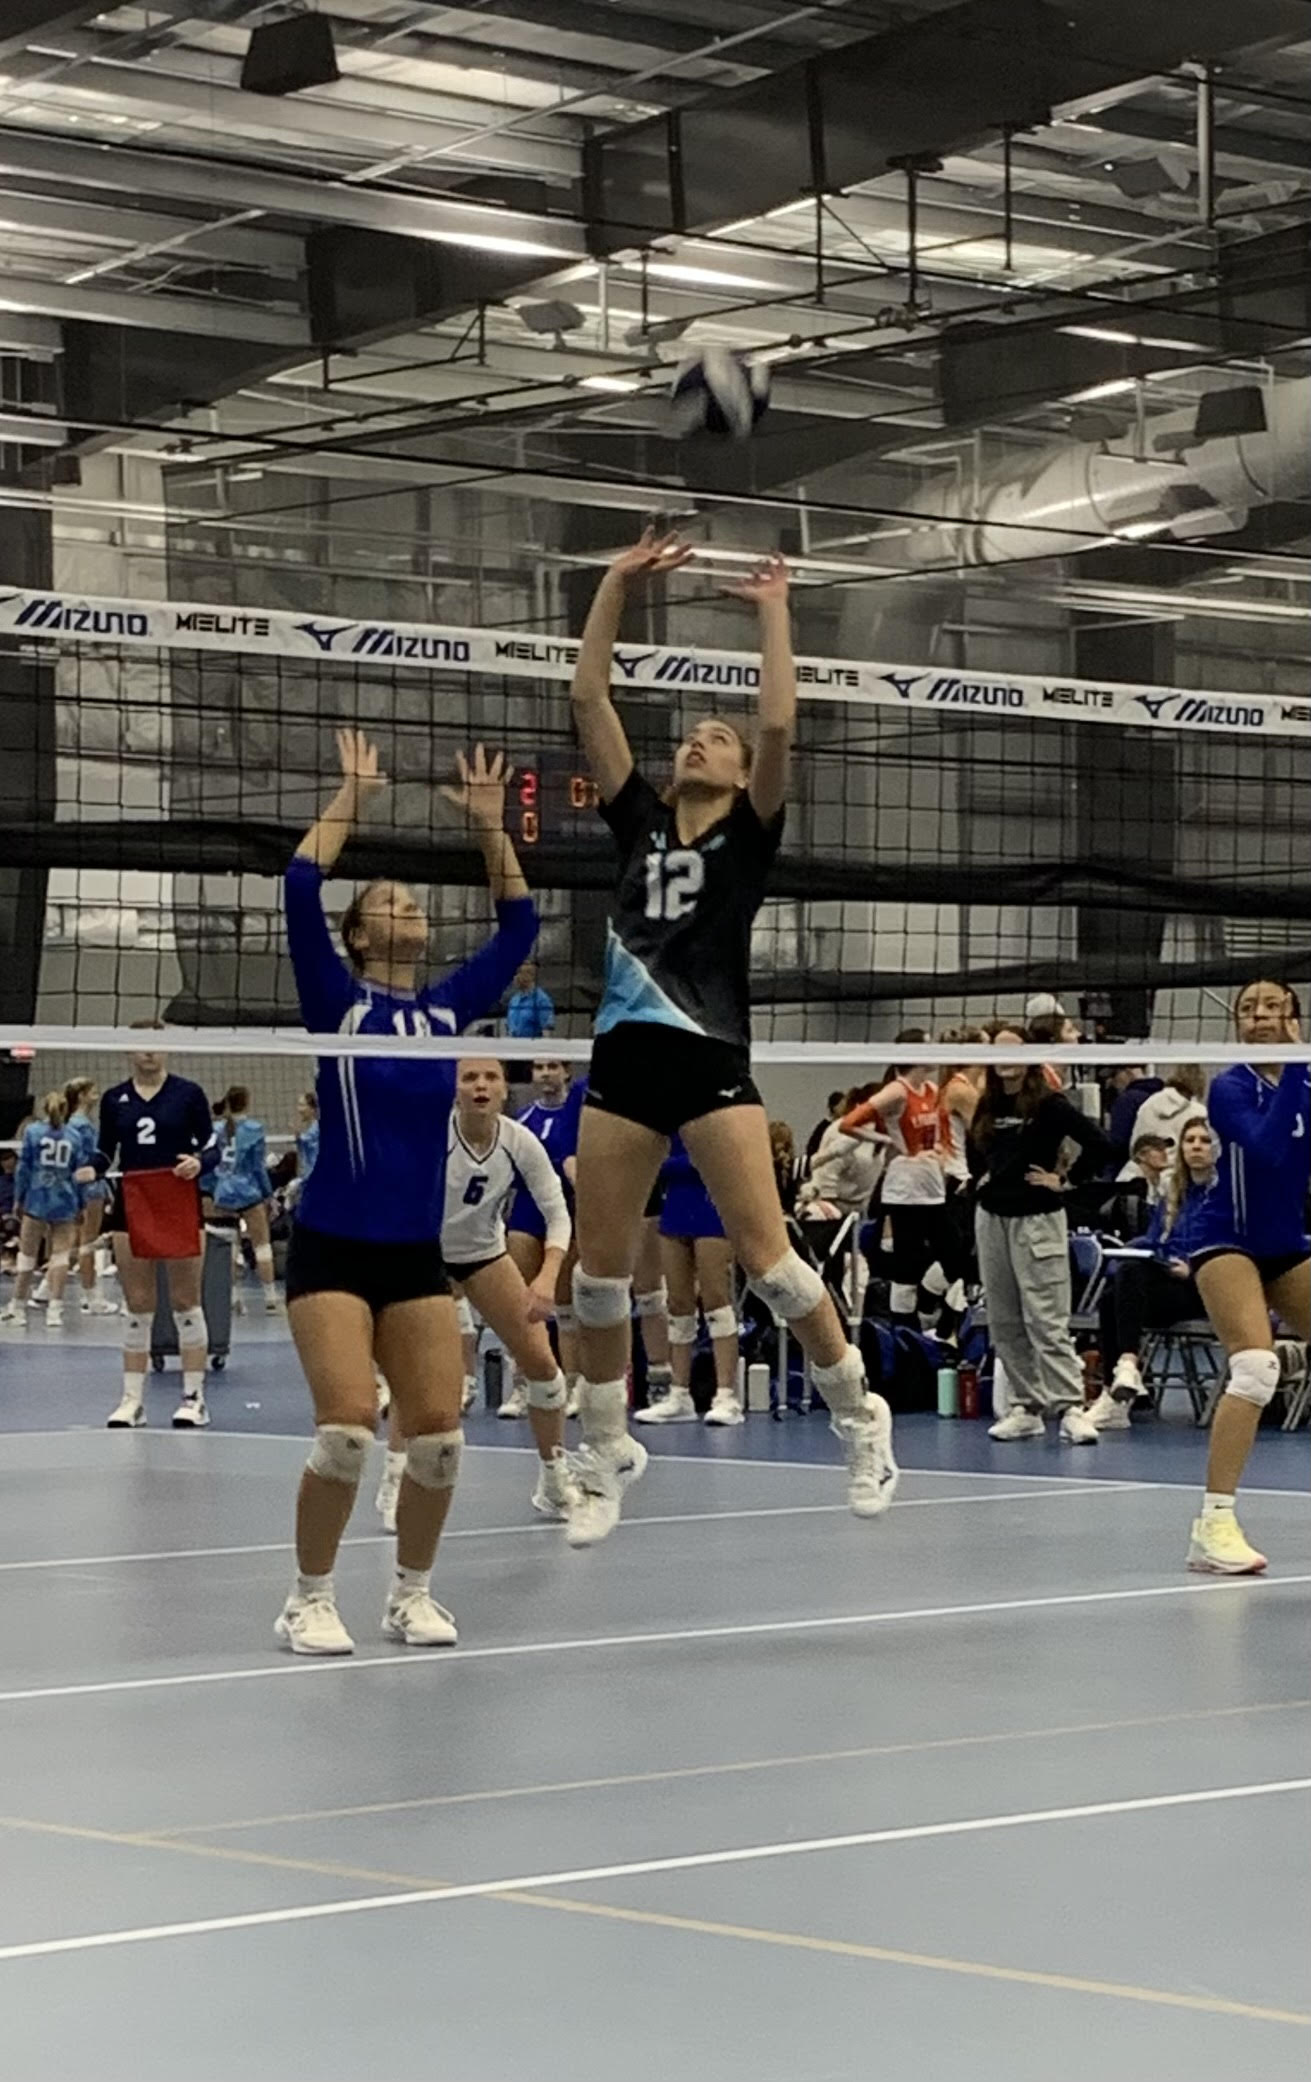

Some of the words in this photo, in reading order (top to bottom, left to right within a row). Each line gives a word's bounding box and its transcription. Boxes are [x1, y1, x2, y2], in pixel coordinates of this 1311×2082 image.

[14, 599, 148, 637] MIZUNO
[351, 627, 471, 662] MIZUNO
[654, 655, 761, 687] MIZUNO
[926, 678, 1024, 707] MIZUNO
[1174, 698, 1264, 726] MIZUNO
[520, 773, 537, 806] 2
[523, 811, 538, 842] 0
[645, 850, 705, 920] 12
[136, 1116, 156, 1145] 2
[40, 1136, 72, 1168] 20
[463, 1175, 489, 1206] 6
